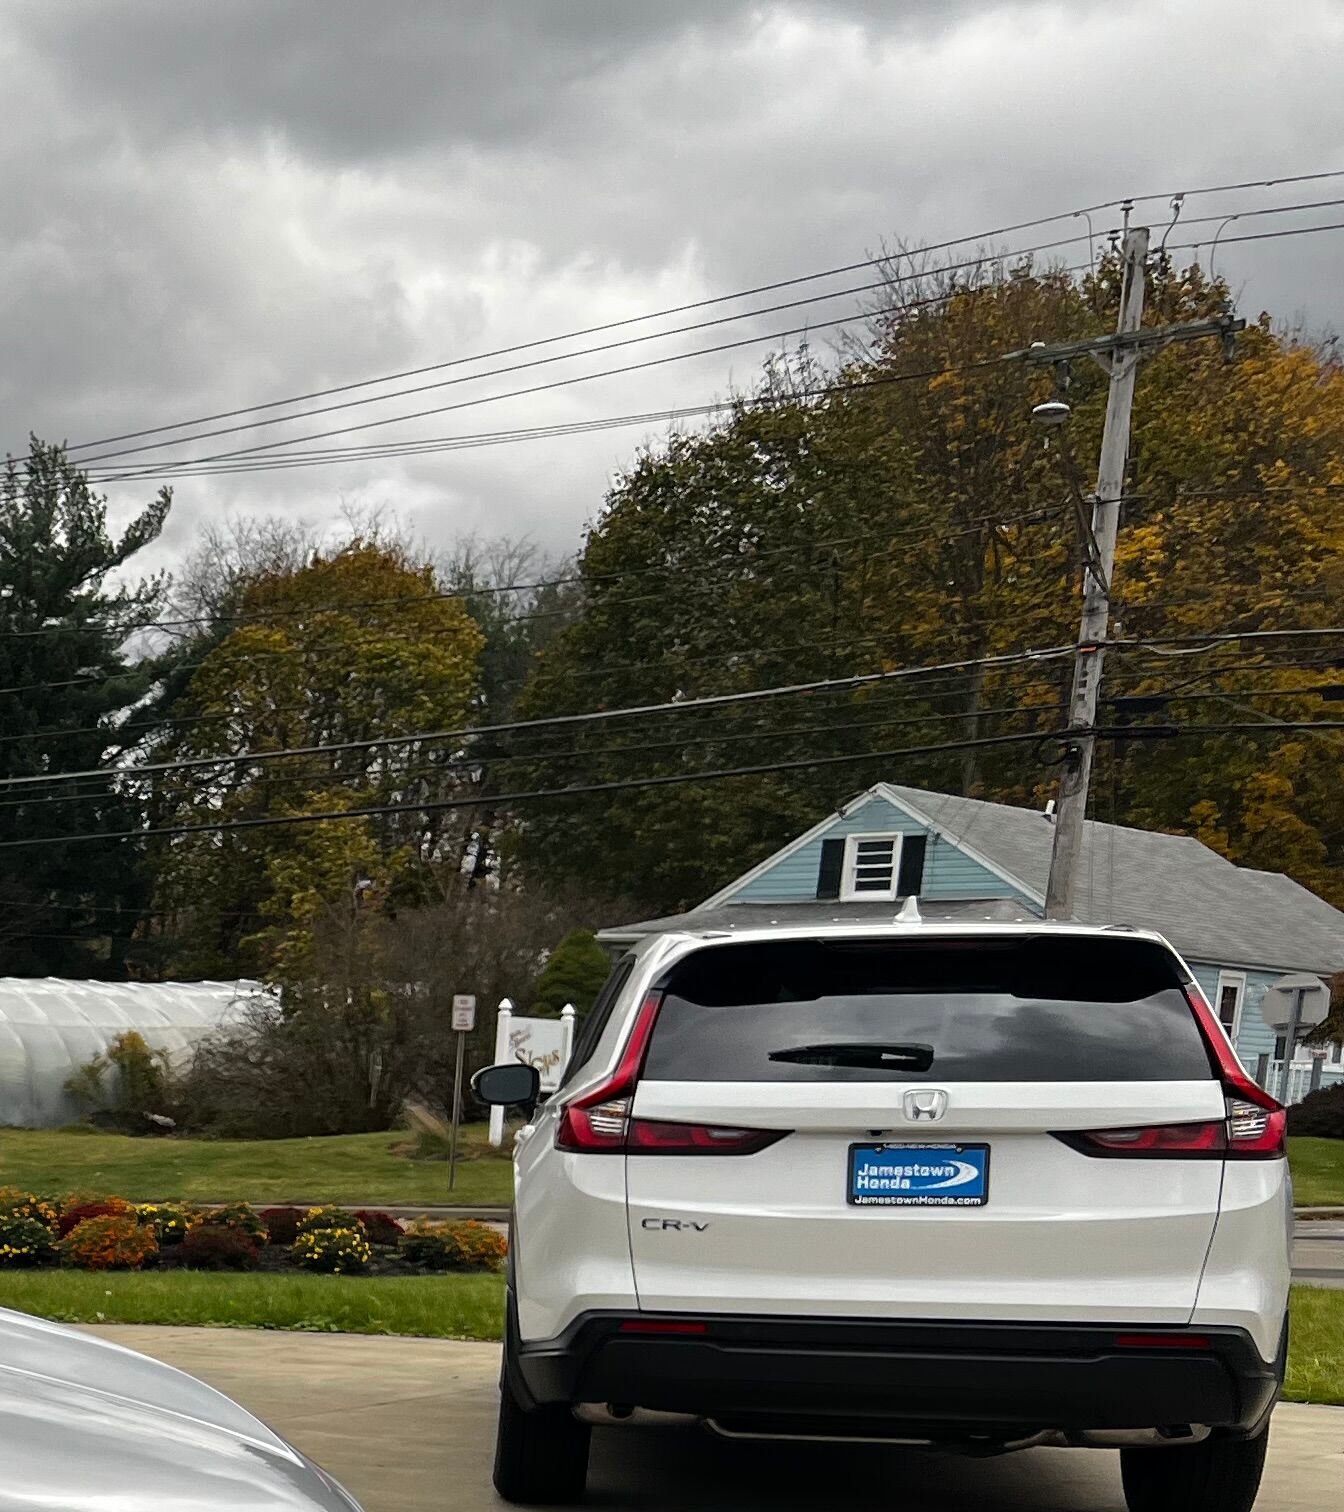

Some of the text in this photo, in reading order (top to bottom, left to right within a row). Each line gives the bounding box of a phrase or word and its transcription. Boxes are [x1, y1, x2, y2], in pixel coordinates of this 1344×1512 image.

[857, 1163, 955, 1178] Jamestown
[856, 1176, 911, 1190] Honda
[854, 1195, 981, 1206] JamestownHonda.com
[640, 1217, 710, 1233] CR-V
